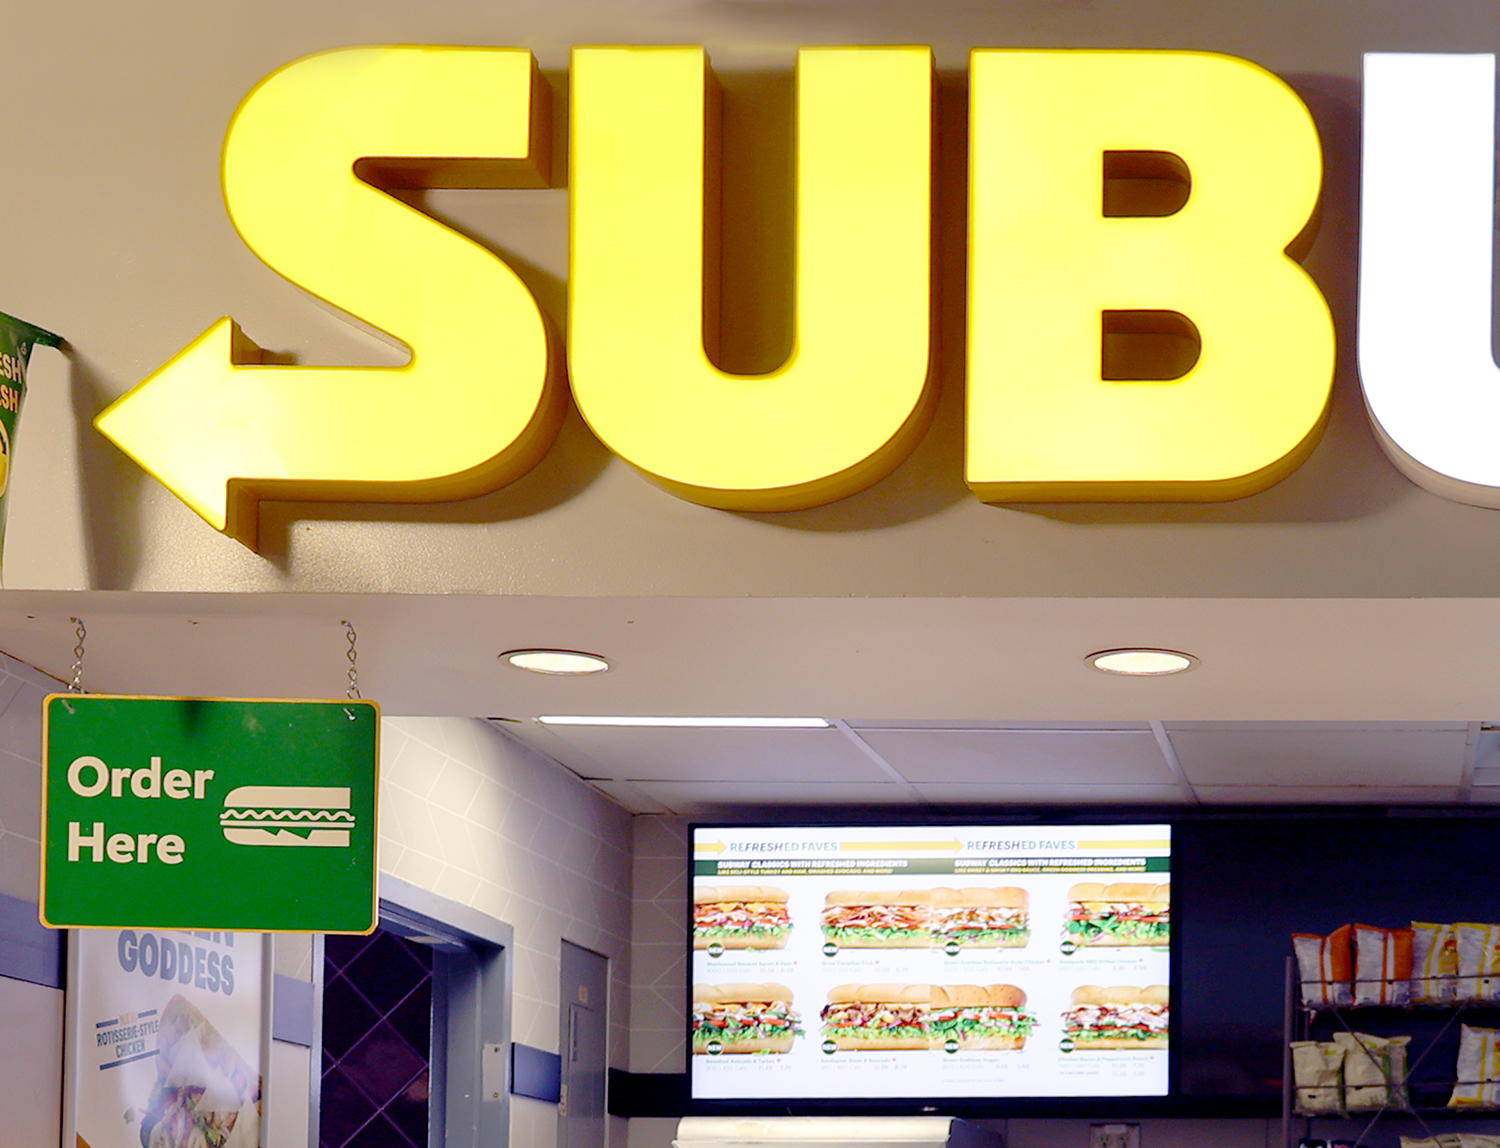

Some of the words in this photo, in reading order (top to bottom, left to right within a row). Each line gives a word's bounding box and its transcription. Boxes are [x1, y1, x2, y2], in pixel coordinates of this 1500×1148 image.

[67, 756, 215, 799] Order
[68, 822, 186, 864] Here
[730, 842, 799, 852] REFRESHED
[802, 842, 837, 852] FAVES
[967, 841, 1036, 850] REFRESHED
[1039, 841, 1075, 849] FAVES
[118, 930, 234, 995] GODDESS
[97, 1020, 159, 1046] ROTISSERIE-STYLE
[116, 1039, 145, 1057] CHICKEN
